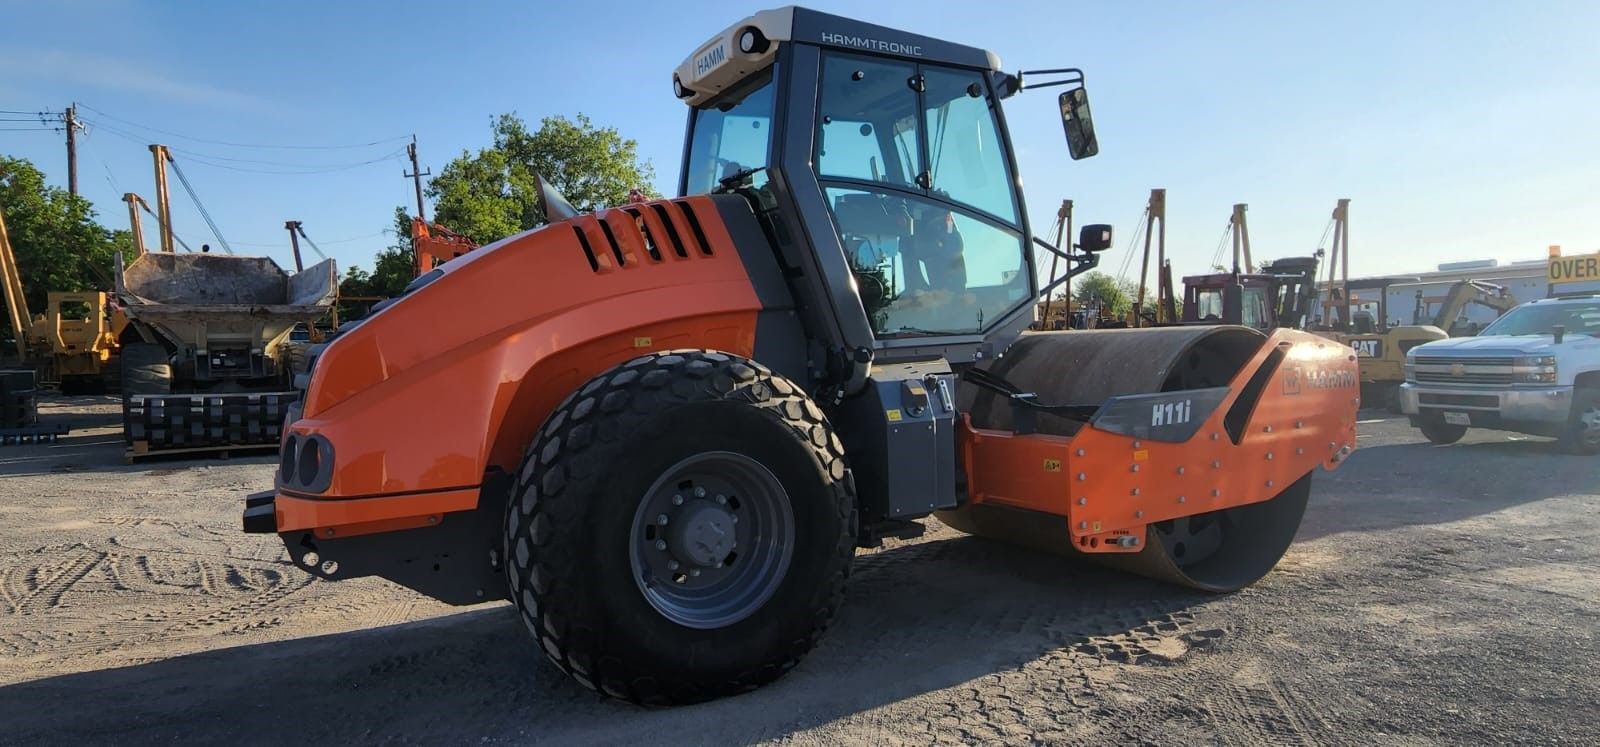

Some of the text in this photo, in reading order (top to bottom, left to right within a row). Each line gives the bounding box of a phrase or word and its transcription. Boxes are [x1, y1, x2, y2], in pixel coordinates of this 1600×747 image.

[822, 32, 922, 56] HAMMTRONIC
[697, 44, 725, 75] HAMM
[1550, 258, 1598, 280] OVER
[1351, 340, 1378, 357] CAT
[1306, 370, 1356, 390] HAMM
[1151, 399, 1191, 427] H11i
